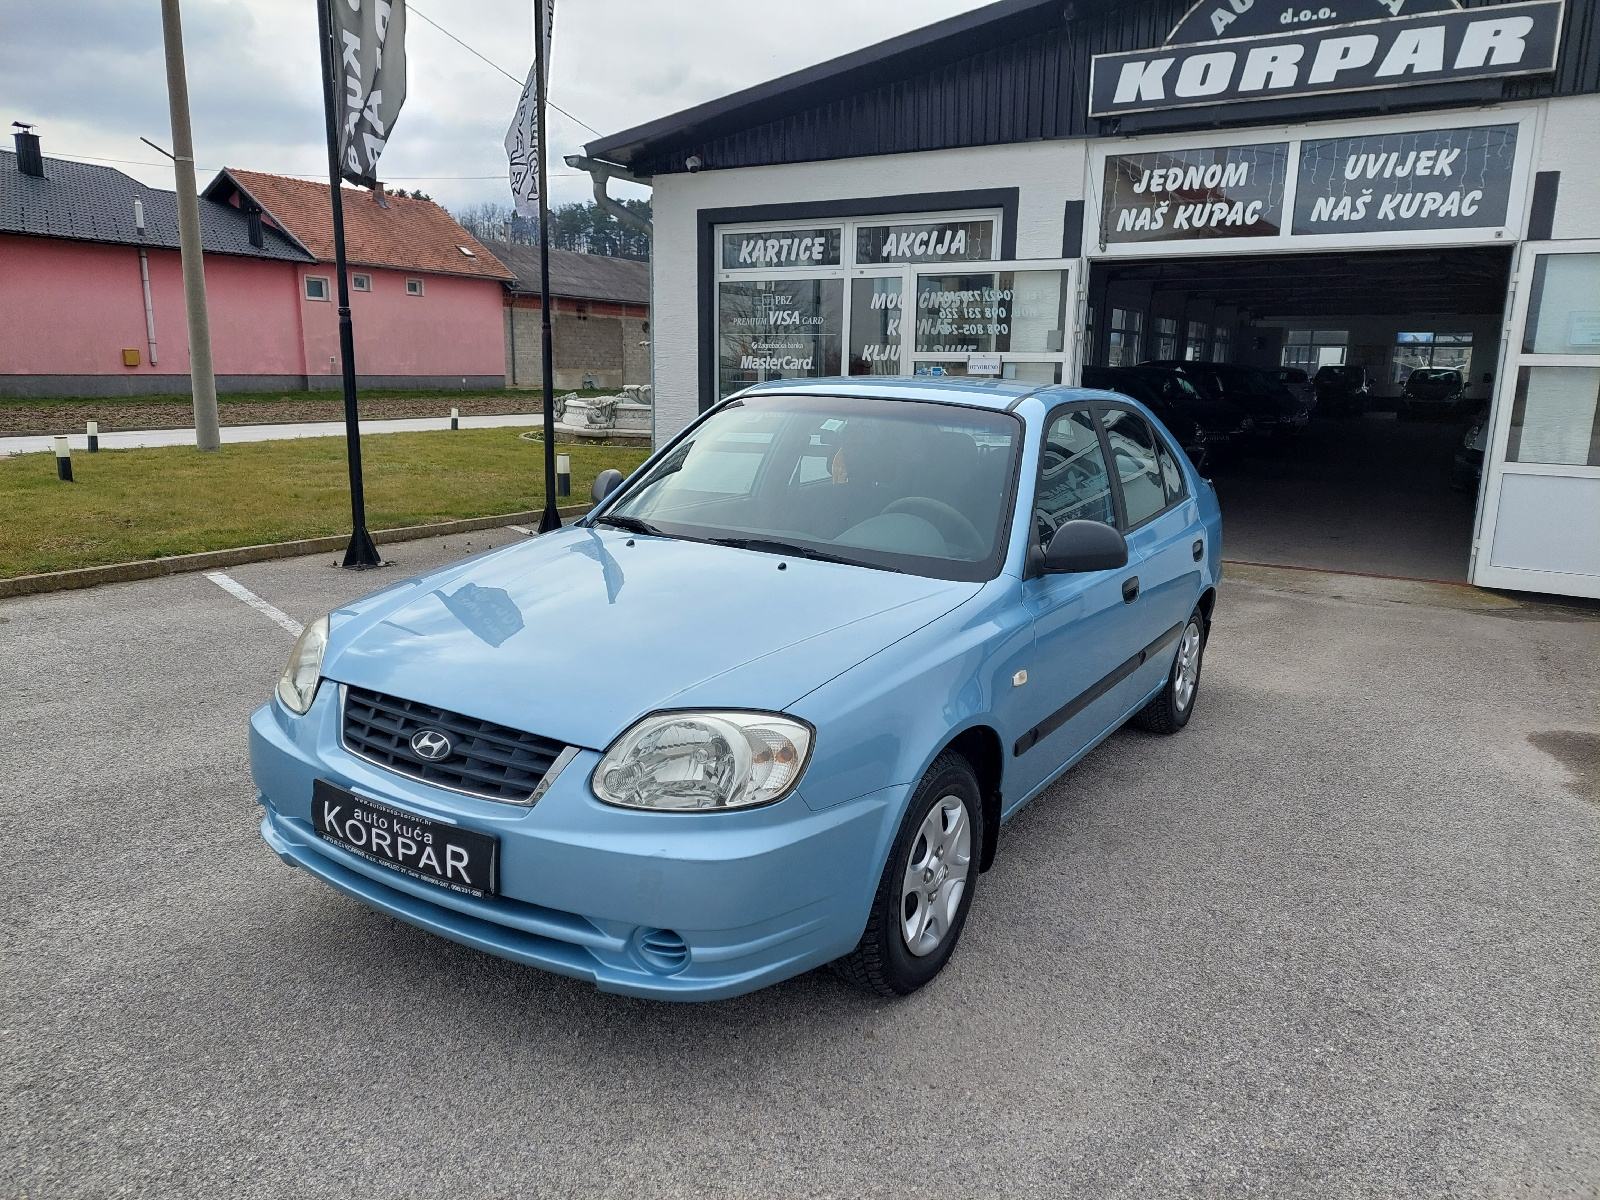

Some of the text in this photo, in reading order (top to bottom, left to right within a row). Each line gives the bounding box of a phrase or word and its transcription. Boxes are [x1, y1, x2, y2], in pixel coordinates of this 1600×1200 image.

[1280, 7, 1337, 24] d.o.o.
[1112, 16, 1534, 104] KORPAR
[1133, 162, 1249, 194] JEDNOM
[1344, 148, 1461, 180] UVIJEK
[1116, 200, 1263, 232] NAŠ KUPAC
[1310, 188, 1483, 222] NAŠ KUPAC
[738, 237, 826, 265] KARTICE
[881, 229, 966, 258] AKCIJA
[775, 295, 793, 305] PBZ
[733, 310, 824, 326] PREMIUM VISA CARD
[323, 800, 472, 884] KORPAR
[353, 808, 432, 845] auto kuća
